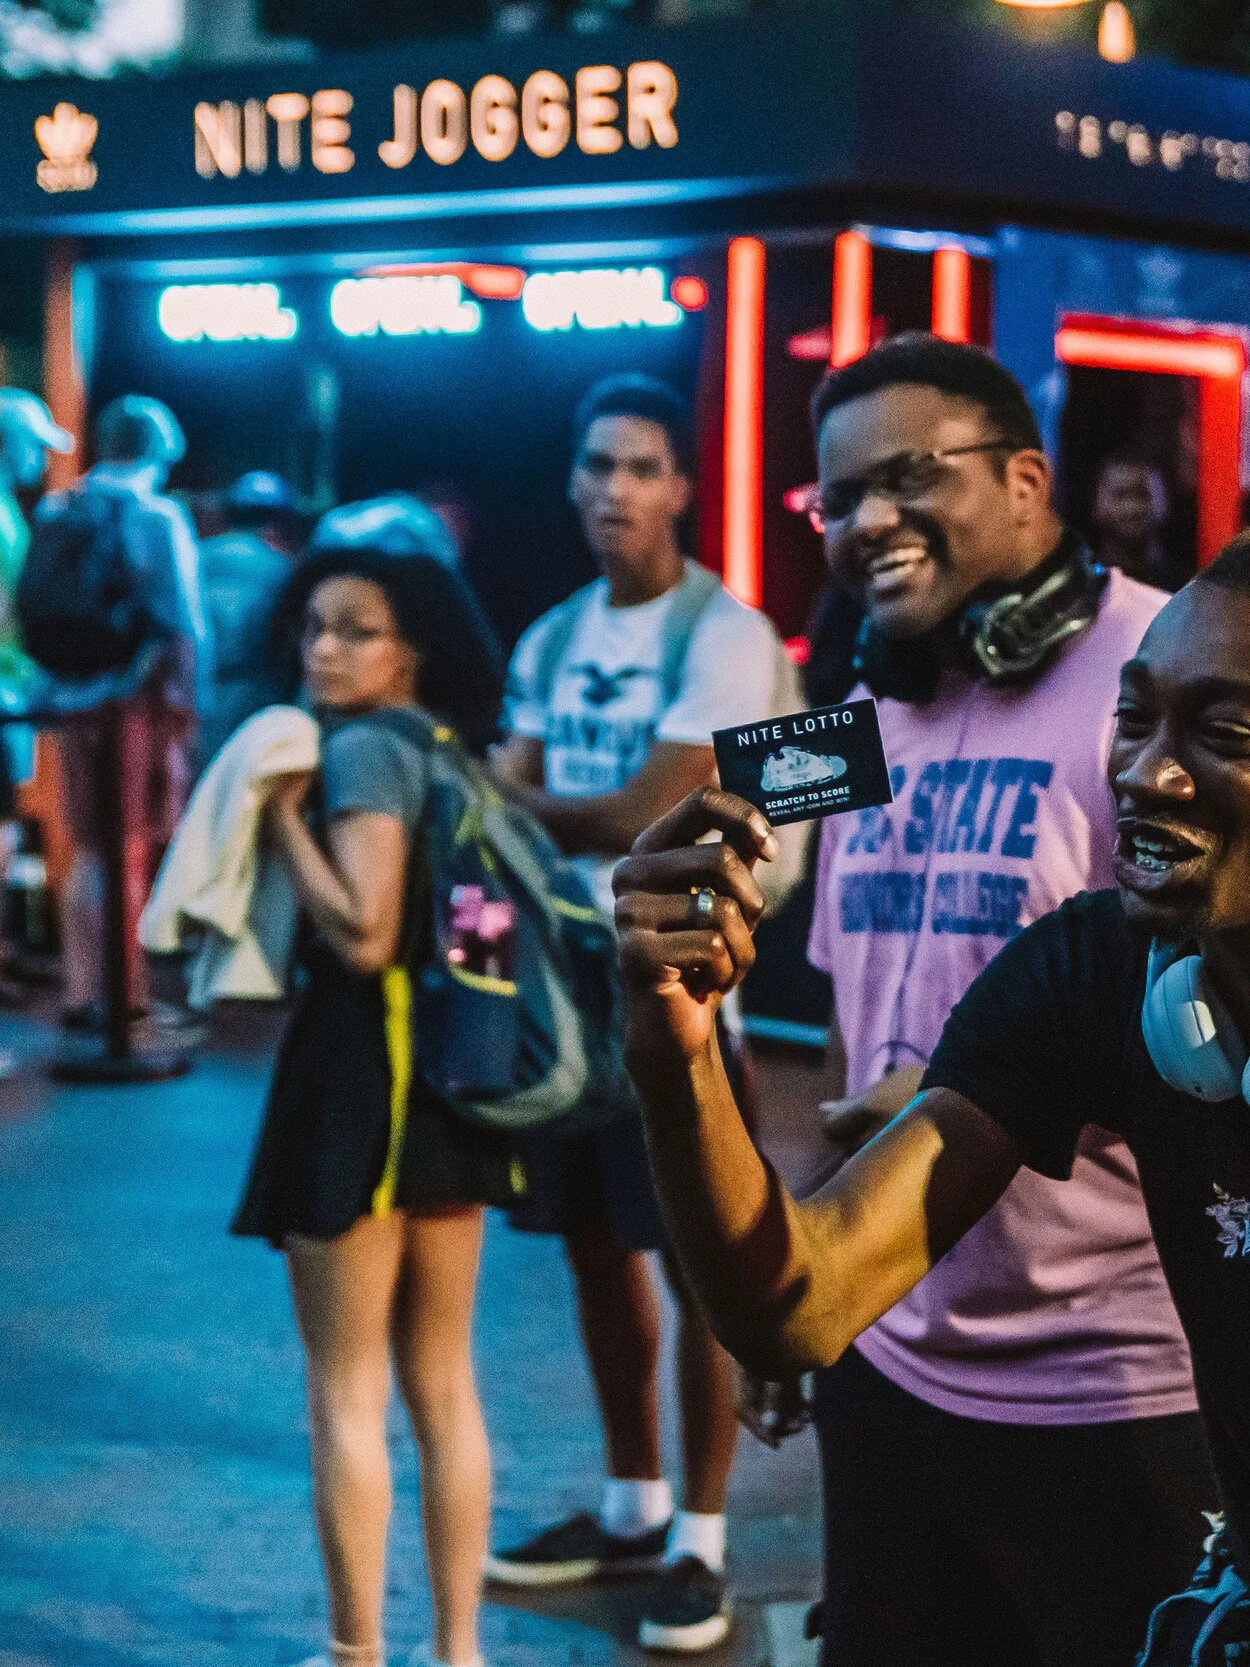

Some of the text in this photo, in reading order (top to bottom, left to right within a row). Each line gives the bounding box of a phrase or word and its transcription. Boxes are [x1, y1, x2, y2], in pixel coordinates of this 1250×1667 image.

[194, 60, 679, 178] NITE JOGGER
[737, 710, 854, 747] NITE LOTTO
[765, 785, 851, 810] SCRATCH TO SCORE
[768, 808, 792, 817] REVEAL
[822, 799, 835, 807] AND
[904, 758, 1054, 859] STATE
